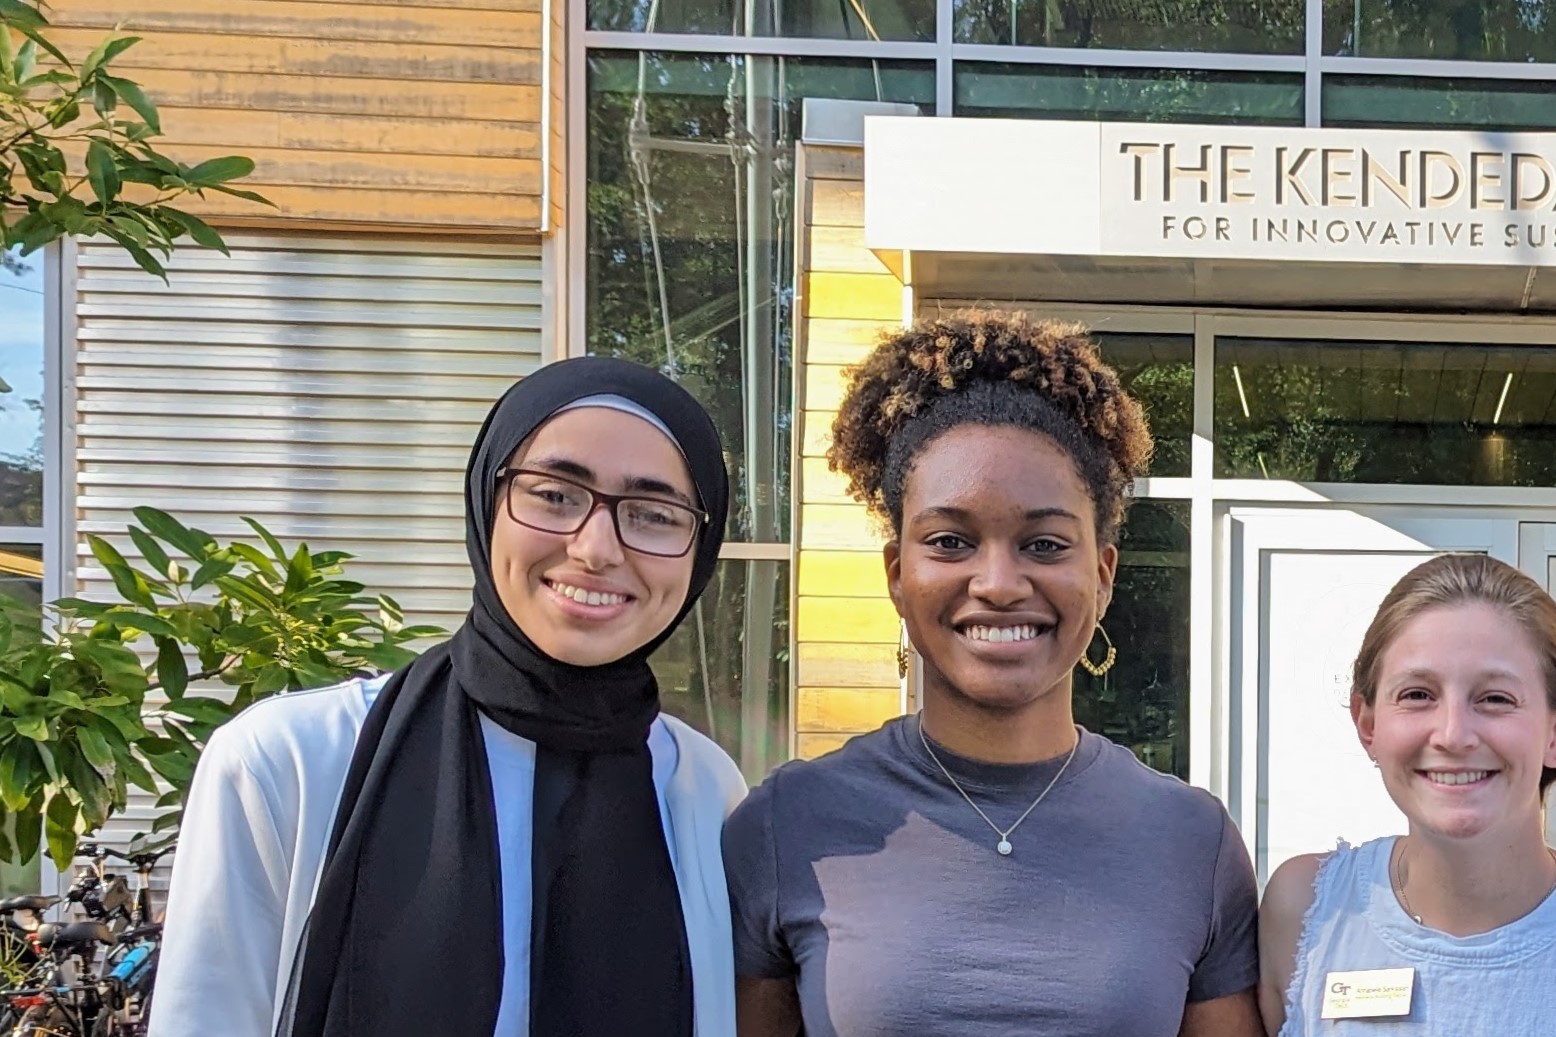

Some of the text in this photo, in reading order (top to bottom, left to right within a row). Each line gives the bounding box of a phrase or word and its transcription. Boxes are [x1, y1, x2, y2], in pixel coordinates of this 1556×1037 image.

[1119, 142, 1256, 204] THE
[1162, 215, 1231, 241] FOR
[1252, 217, 1484, 247] INNOVATIVE
[1331, 982, 1352, 996] GT
